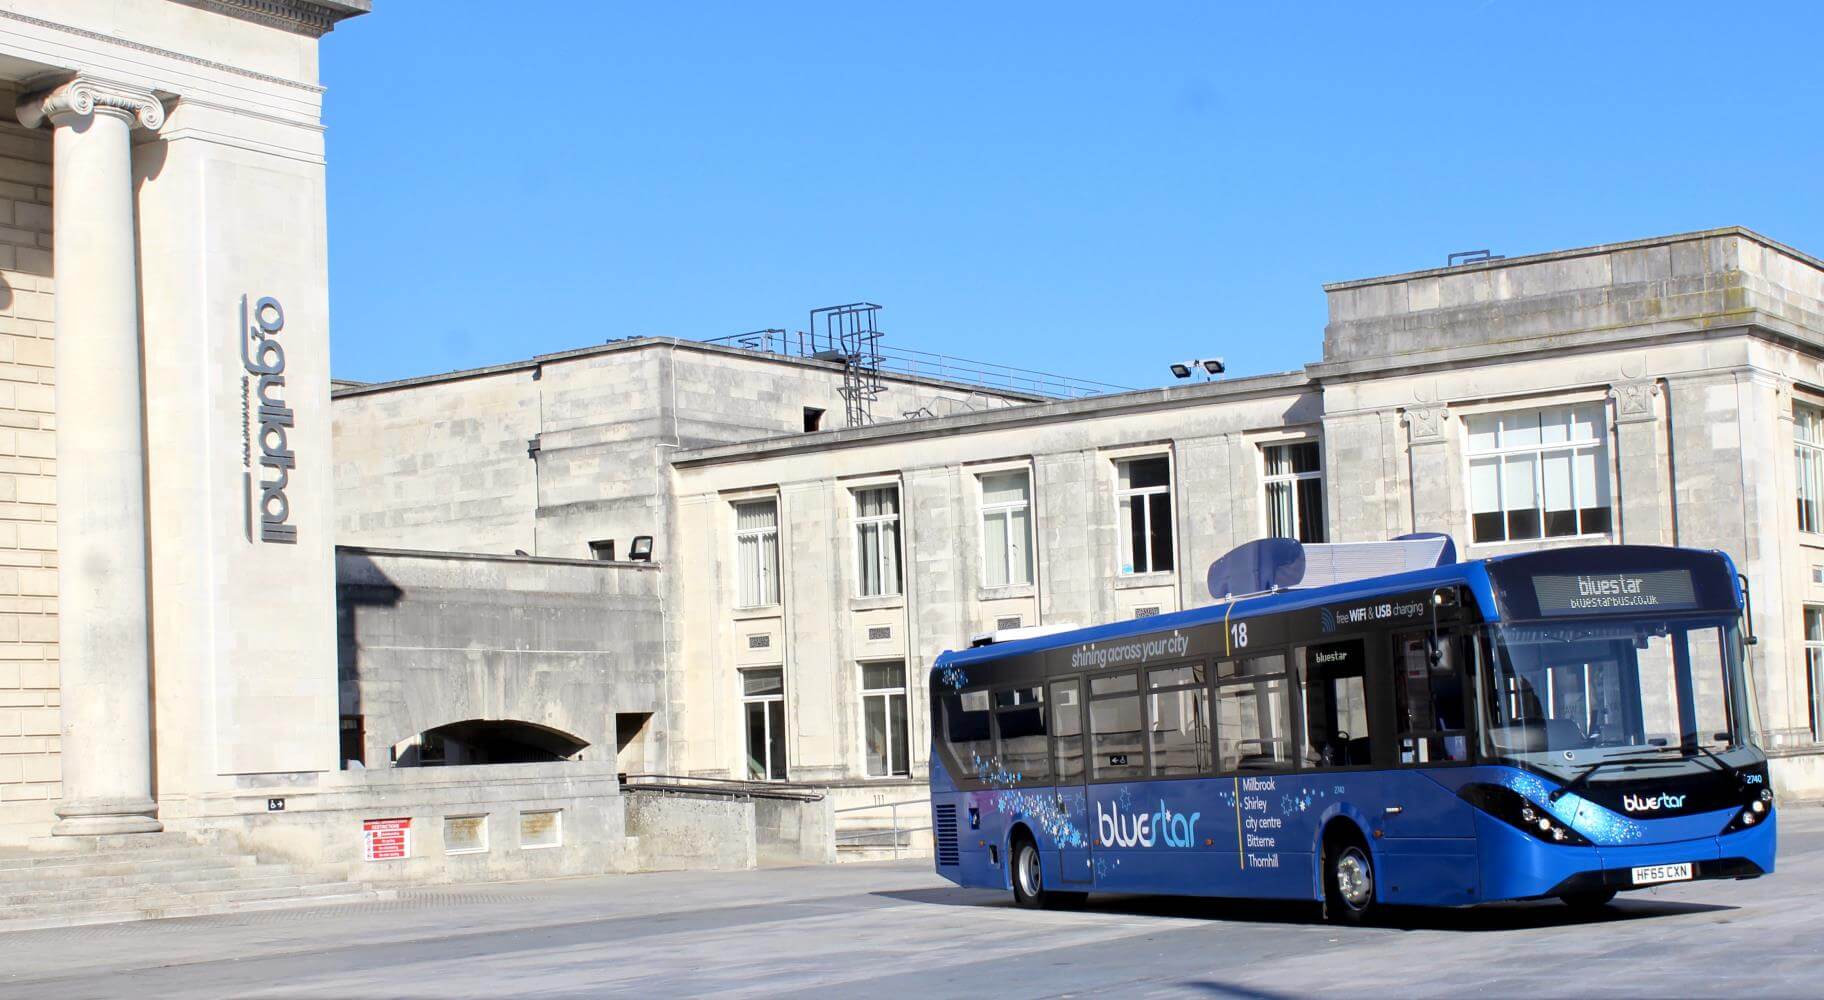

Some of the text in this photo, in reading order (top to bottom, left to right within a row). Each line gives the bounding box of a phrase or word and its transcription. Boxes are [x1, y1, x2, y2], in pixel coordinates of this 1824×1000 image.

[248, 339, 298, 544] guildhall
[1577, 574, 1643, 595] bluestar
[1570, 595, 1658, 608] bluestarbus.co.uk
[1336, 601, 1424, 624] free WiFi & USB charging
[1230, 622, 1248, 648] 18
[1071, 629, 1189, 668] shining across your city
[1315, 651, 1347, 663] bluestar
[1242, 777, 1276, 792] Millbrook
[1747, 774, 1763, 784] 2740
[1243, 796, 1267, 813] Shirley
[1623, 791, 1686, 811] bluestar
[1097, 798, 1200, 847] bluestar
[1245, 816, 1282, 832] city centre
[1246, 834, 1275, 848] Bitterne
[1248, 853, 1279, 868] Thornhill
[1636, 865, 1687, 880] HF65 CXN
